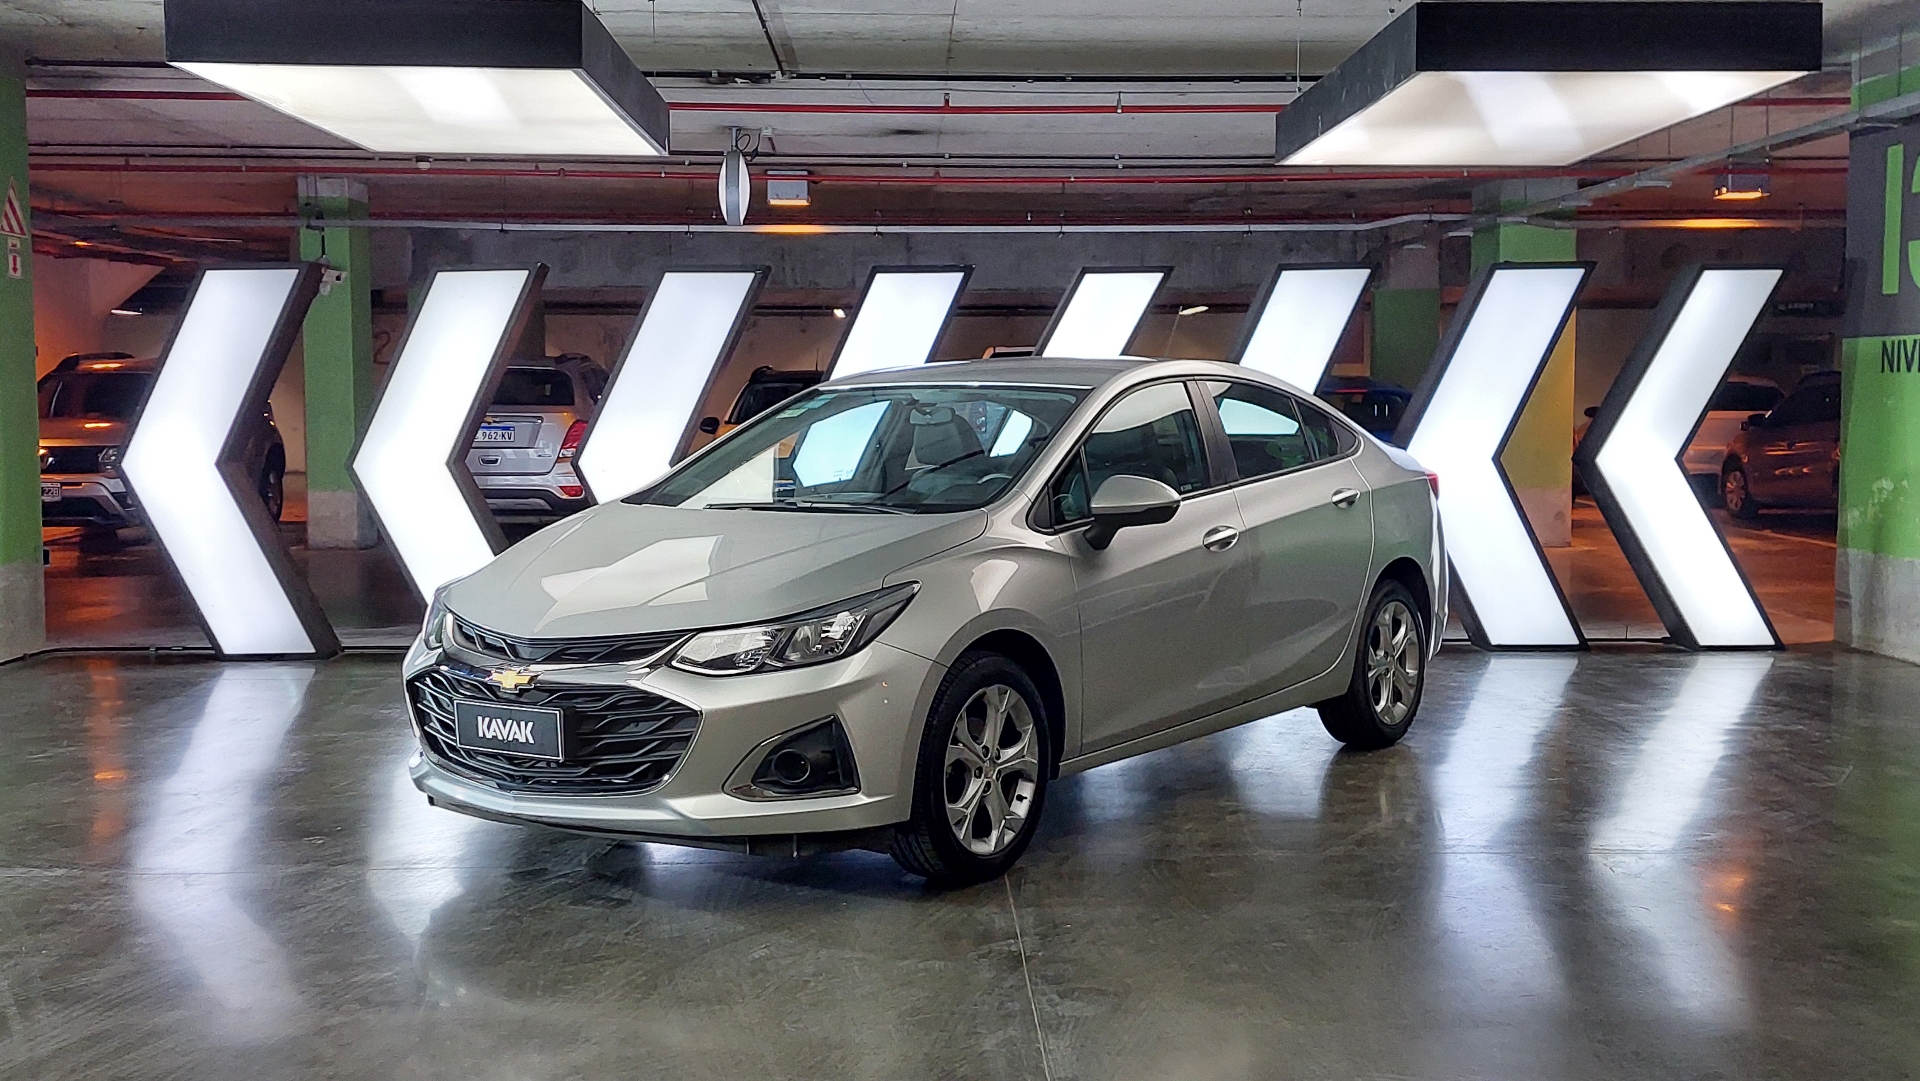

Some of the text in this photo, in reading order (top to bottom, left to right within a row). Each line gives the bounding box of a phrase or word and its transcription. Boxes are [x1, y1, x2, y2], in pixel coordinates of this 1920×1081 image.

[1880, 338, 1920, 374] NIV
[482, 431, 513, 441] 962 KV
[477, 715, 535, 744] KAVAK
